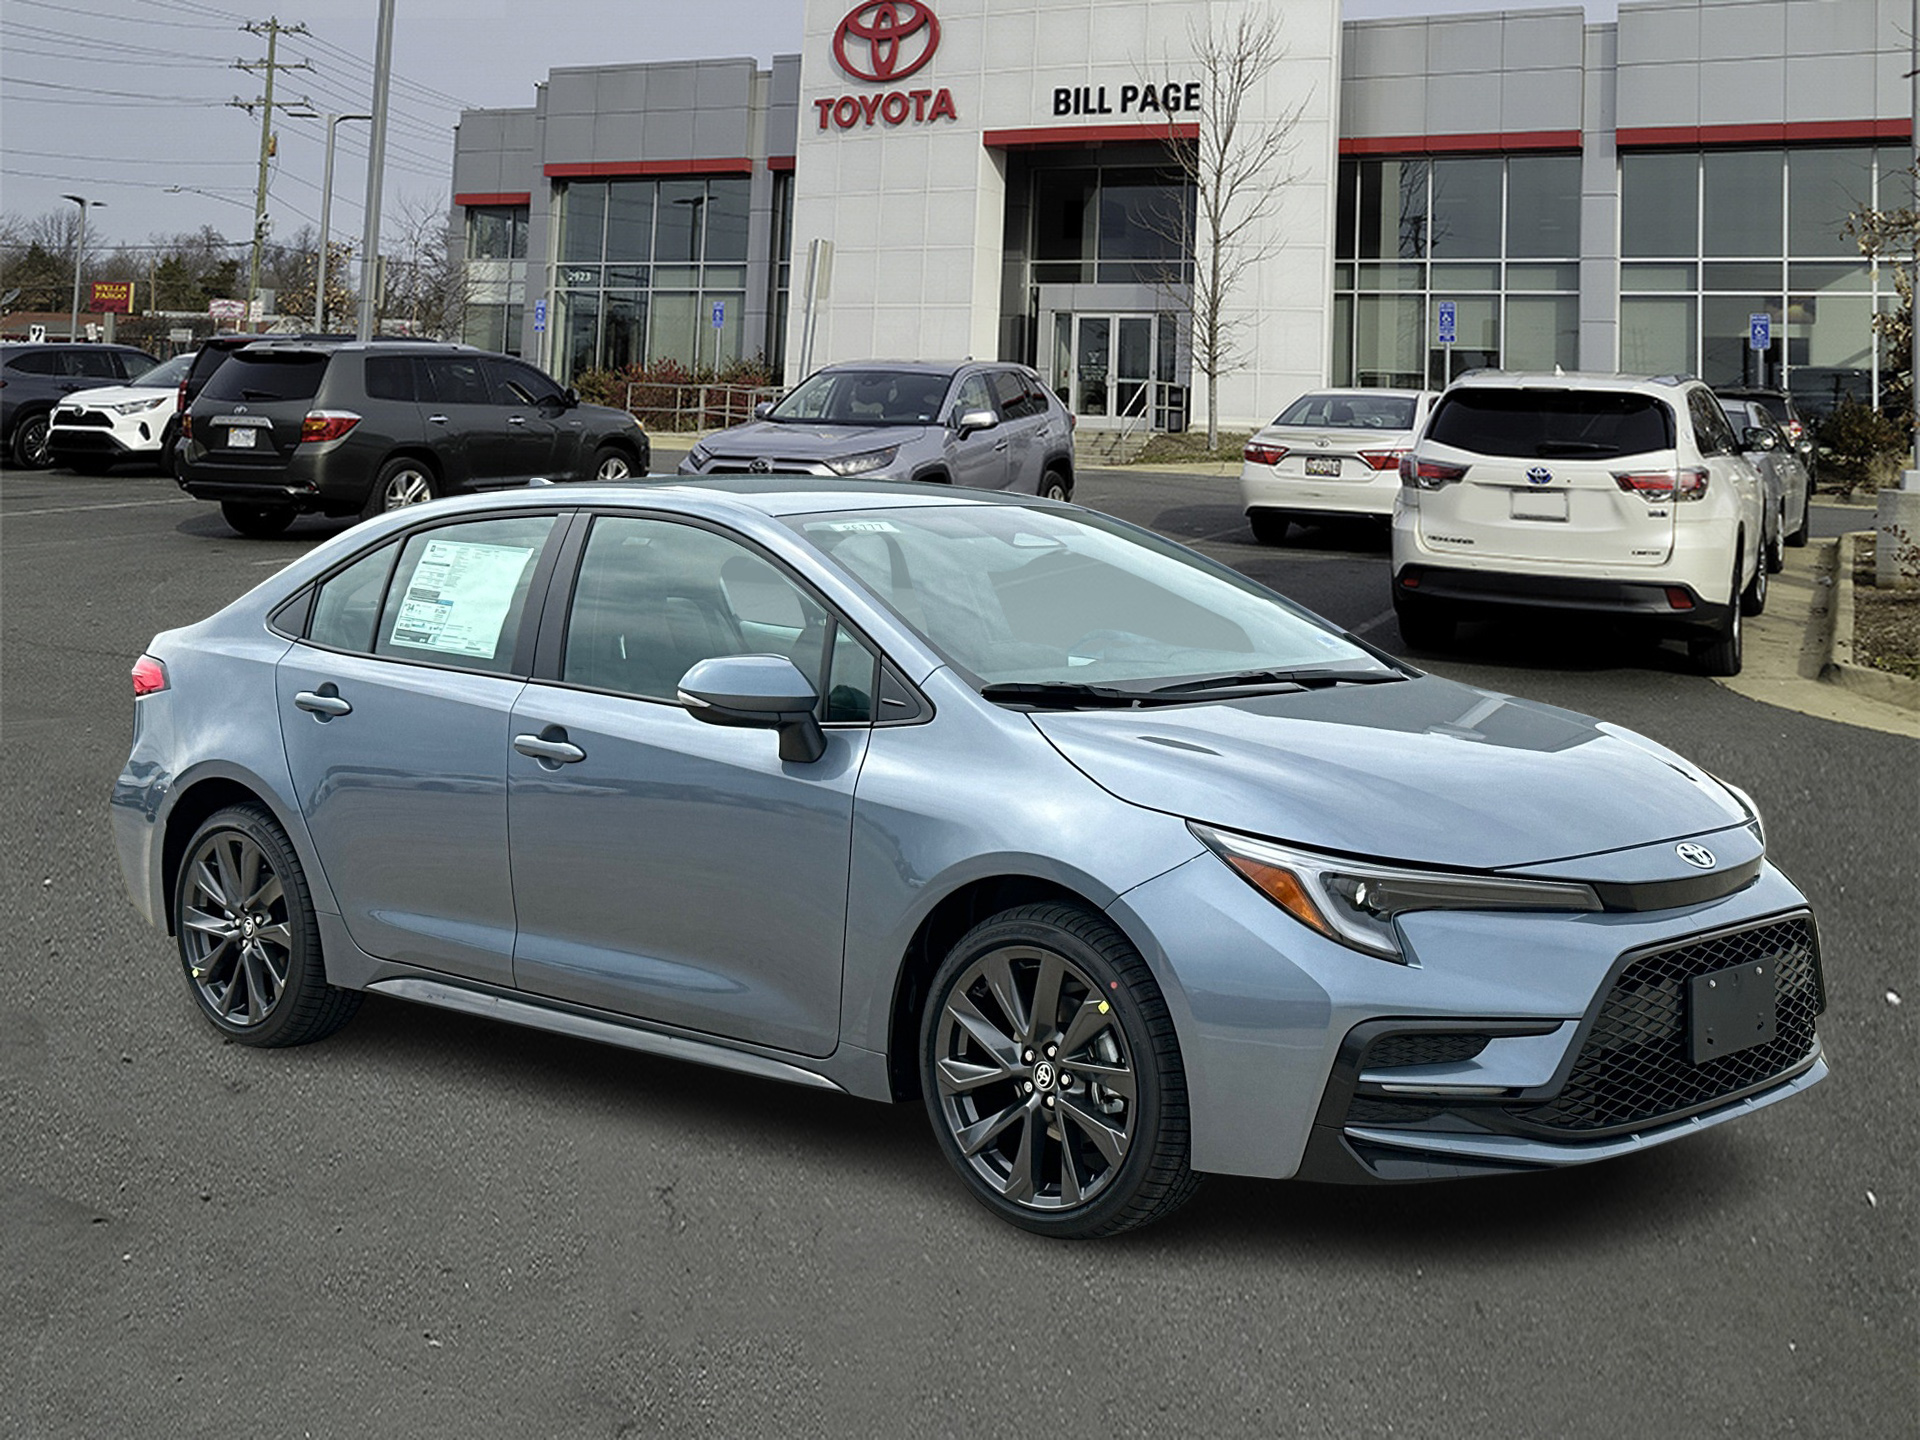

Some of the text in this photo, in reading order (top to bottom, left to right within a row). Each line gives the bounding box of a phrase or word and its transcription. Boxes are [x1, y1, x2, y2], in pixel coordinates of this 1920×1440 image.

[813, 88, 957, 129] TOYOTA
[1053, 82, 1201, 116] BILL PAGE
[567, 271, 591, 282] 2923
[94, 291, 127, 300] FARGO
